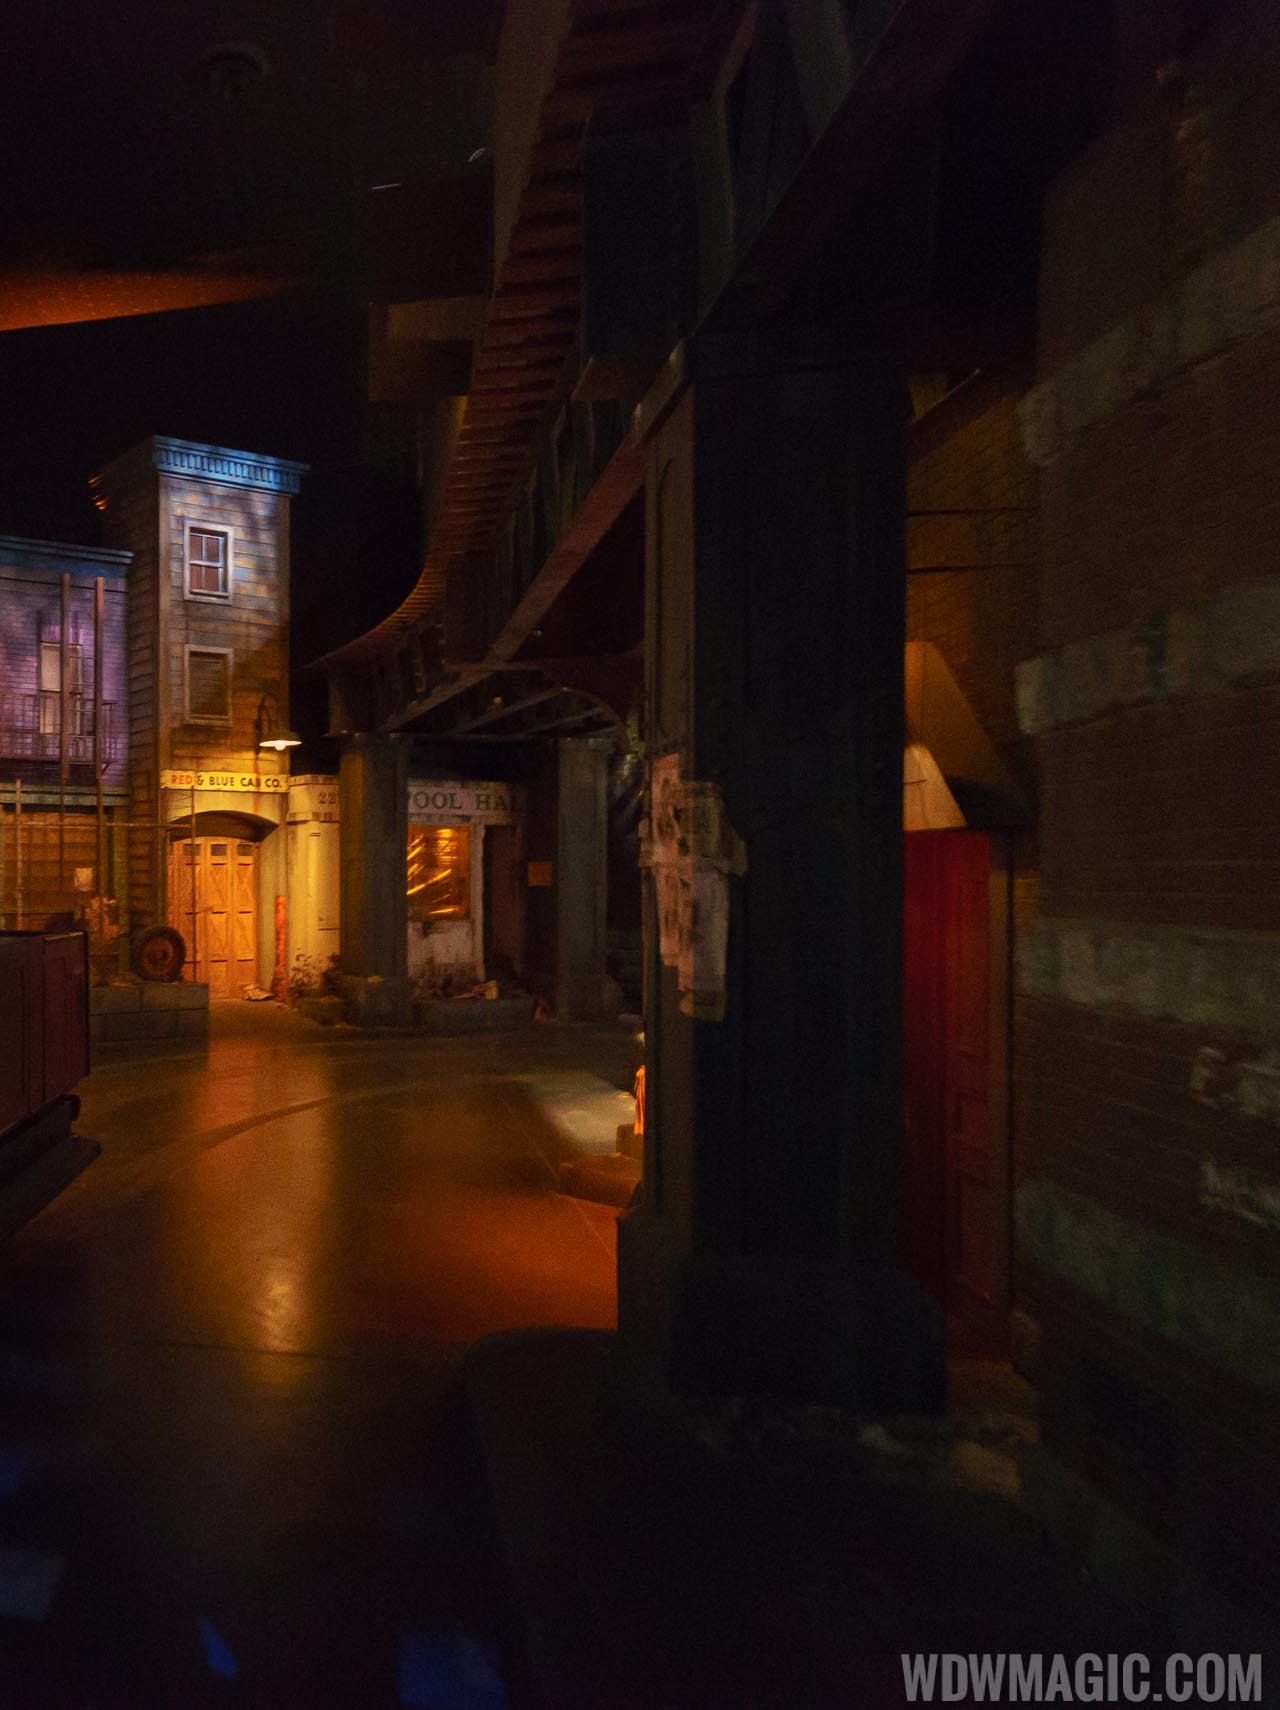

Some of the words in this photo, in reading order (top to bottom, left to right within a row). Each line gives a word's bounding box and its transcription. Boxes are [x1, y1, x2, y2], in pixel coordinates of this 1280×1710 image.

[170, 774, 194, 786] RED
[196, 774, 205, 787] &
[208, 775, 236, 787] BLUE
[406, 790, 463, 811] OOL
